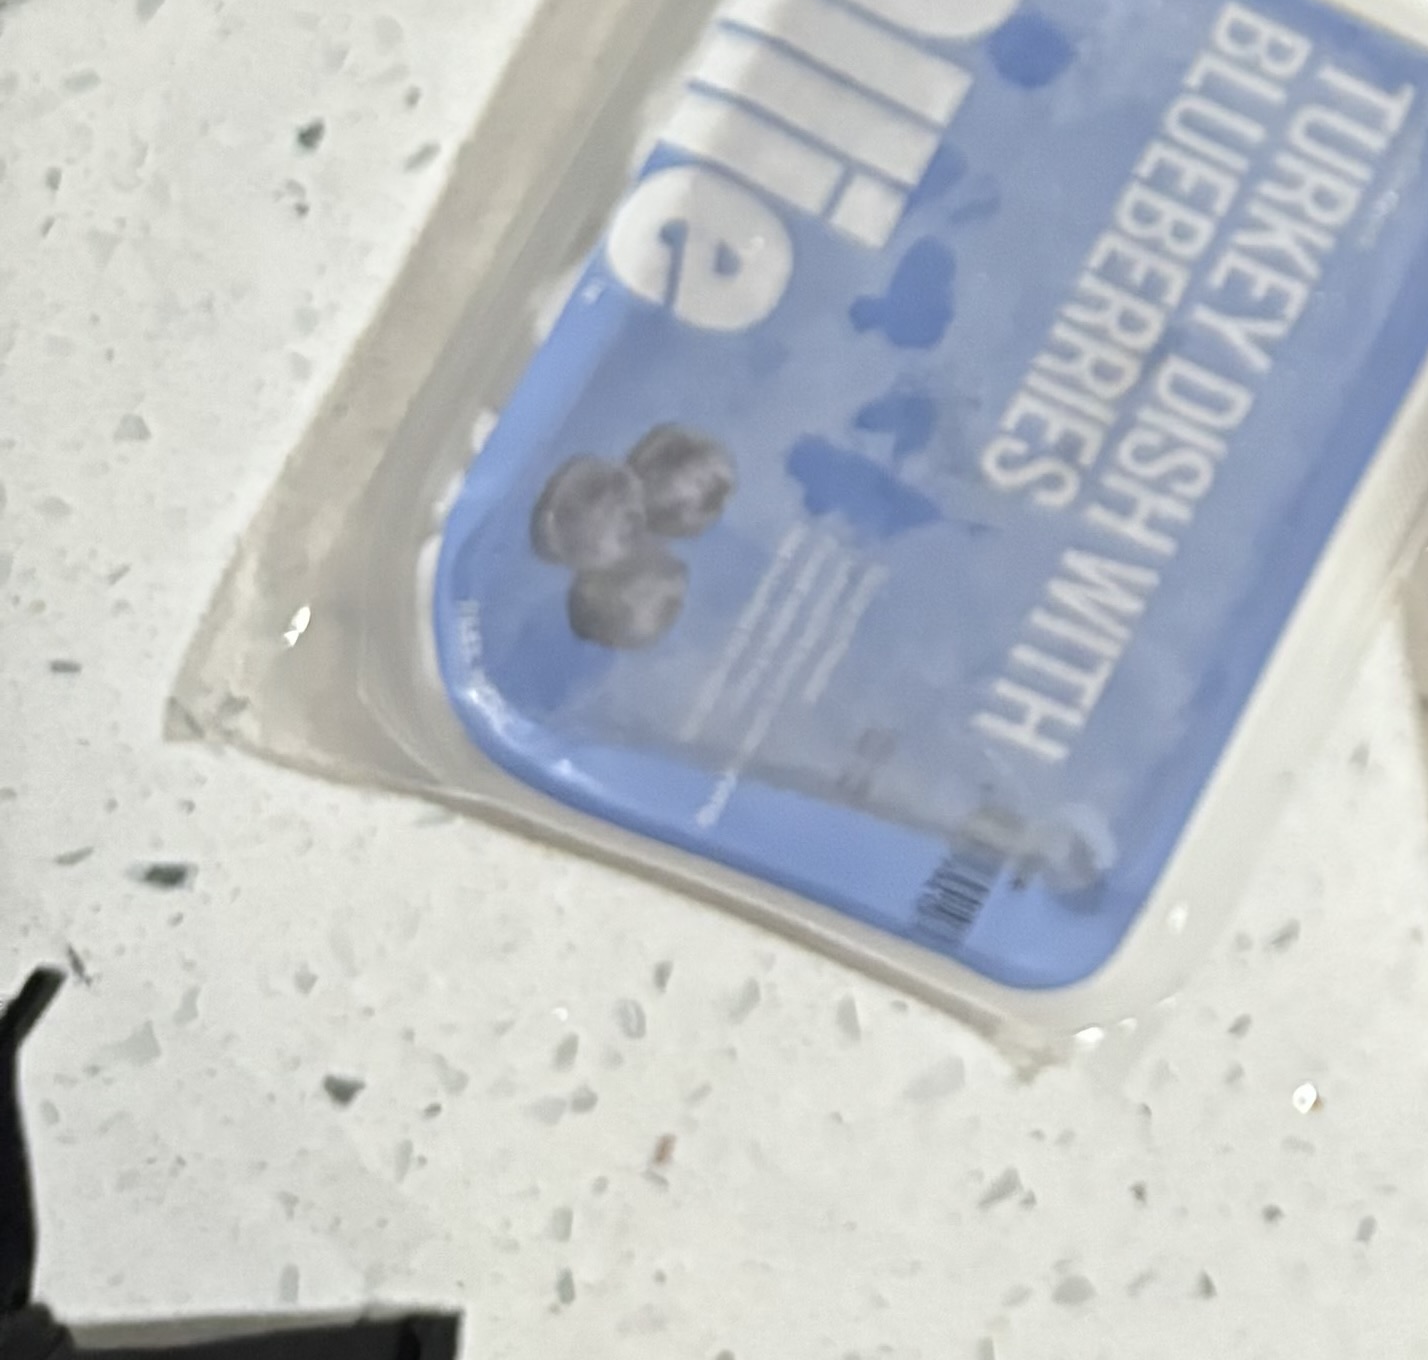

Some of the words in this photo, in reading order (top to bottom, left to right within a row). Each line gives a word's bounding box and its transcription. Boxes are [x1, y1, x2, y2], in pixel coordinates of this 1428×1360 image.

[979, 0, 1314, 509] BLUEBERRIES
[1191, 63, 1416, 375] TURKEY
[1085, 353, 1254, 557] DISH
[968, 547, 1160, 762] WITH
